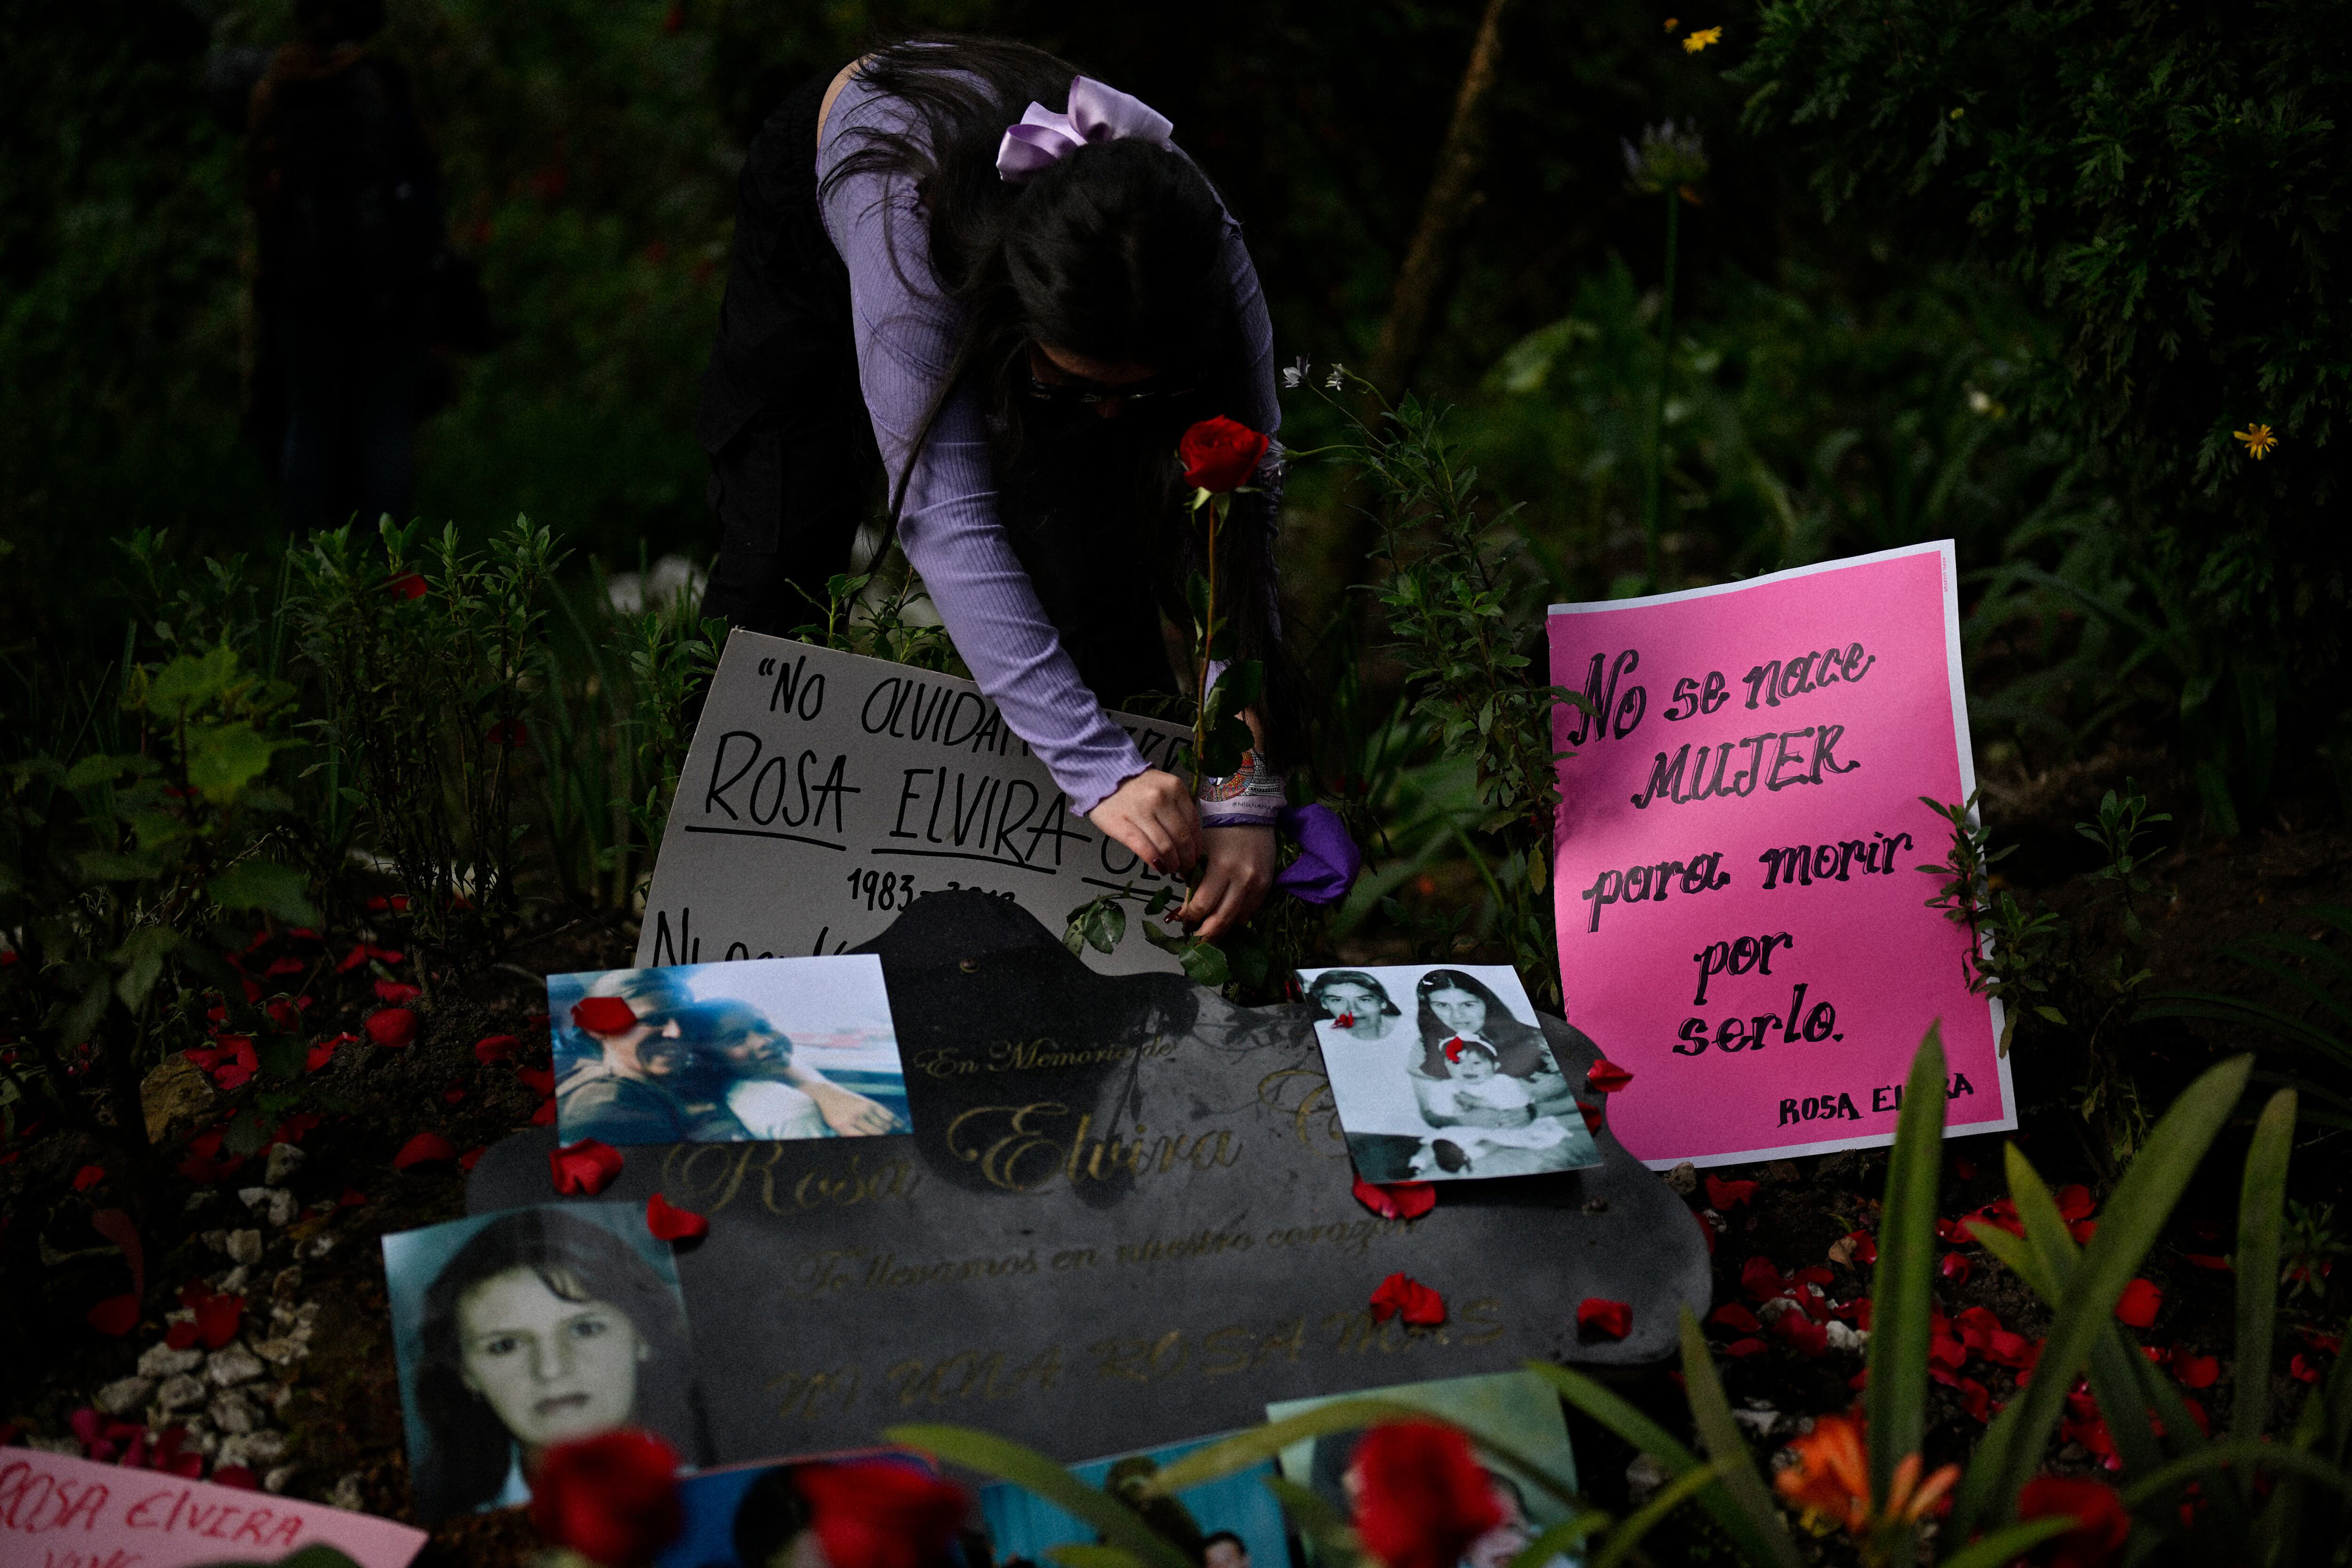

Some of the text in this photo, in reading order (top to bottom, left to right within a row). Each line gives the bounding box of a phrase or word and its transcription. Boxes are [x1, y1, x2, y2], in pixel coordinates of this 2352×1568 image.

[1567, 643, 1876, 746] No se nace
[705, 731, 861, 833] ROSA
[890, 767, 1092, 866] ELVIRA
[1630, 724, 1862, 809] MUJER
[1583, 831, 1914, 933] para morir
[1693, 931, 1793, 1005] por
[1673, 983, 1844, 1056] serlo.
[913, 1047, 979, 1079] En
[1777, 1092, 1864, 1127] ROSA
[661, 1142, 924, 1216] Rosa
[947, 1101, 1244, 1196] Elvira
